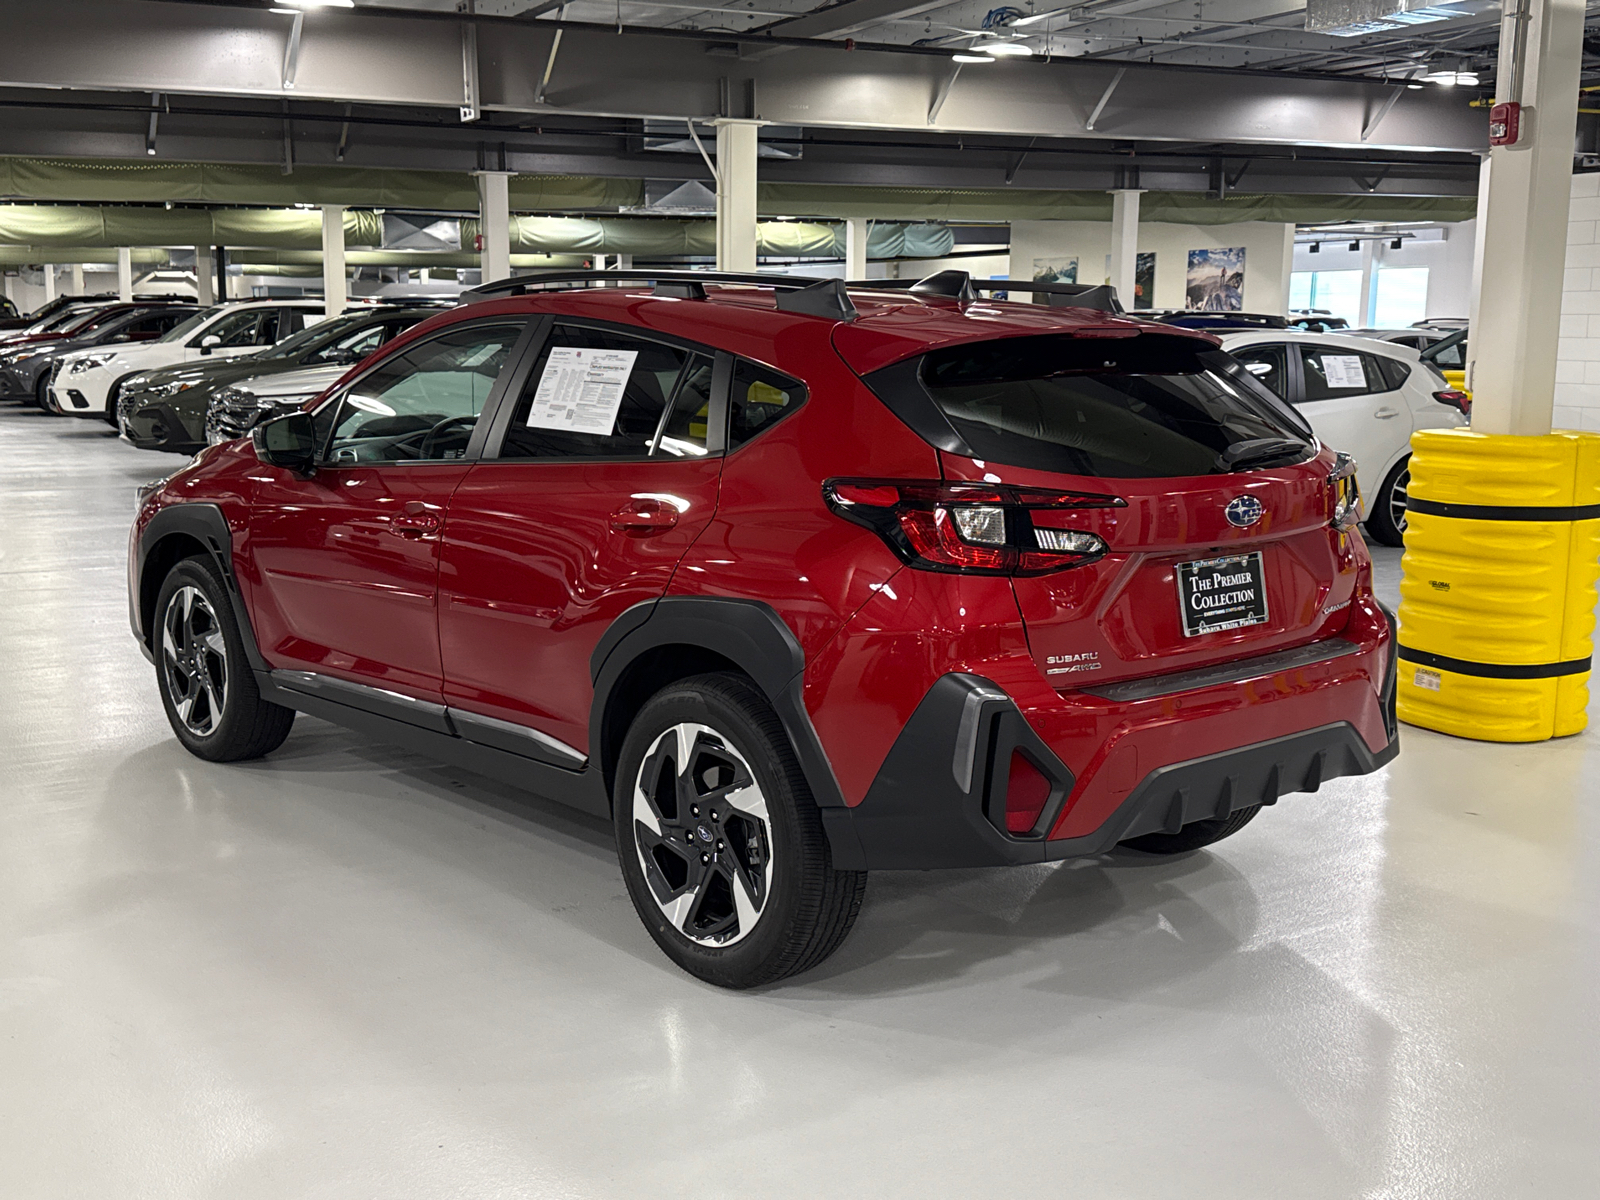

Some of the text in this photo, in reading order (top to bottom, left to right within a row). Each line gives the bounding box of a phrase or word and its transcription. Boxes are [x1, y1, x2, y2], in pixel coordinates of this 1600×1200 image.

[1189, 572, 1253, 592] THE PREMIER
[1191, 588, 1255, 611] COLLECTION
[1221, 621, 1239, 630] White
[1239, 619, 1257, 627] Plains
[1047, 652, 1098, 664] SUBARU
[1068, 662, 1102, 672] AWD
